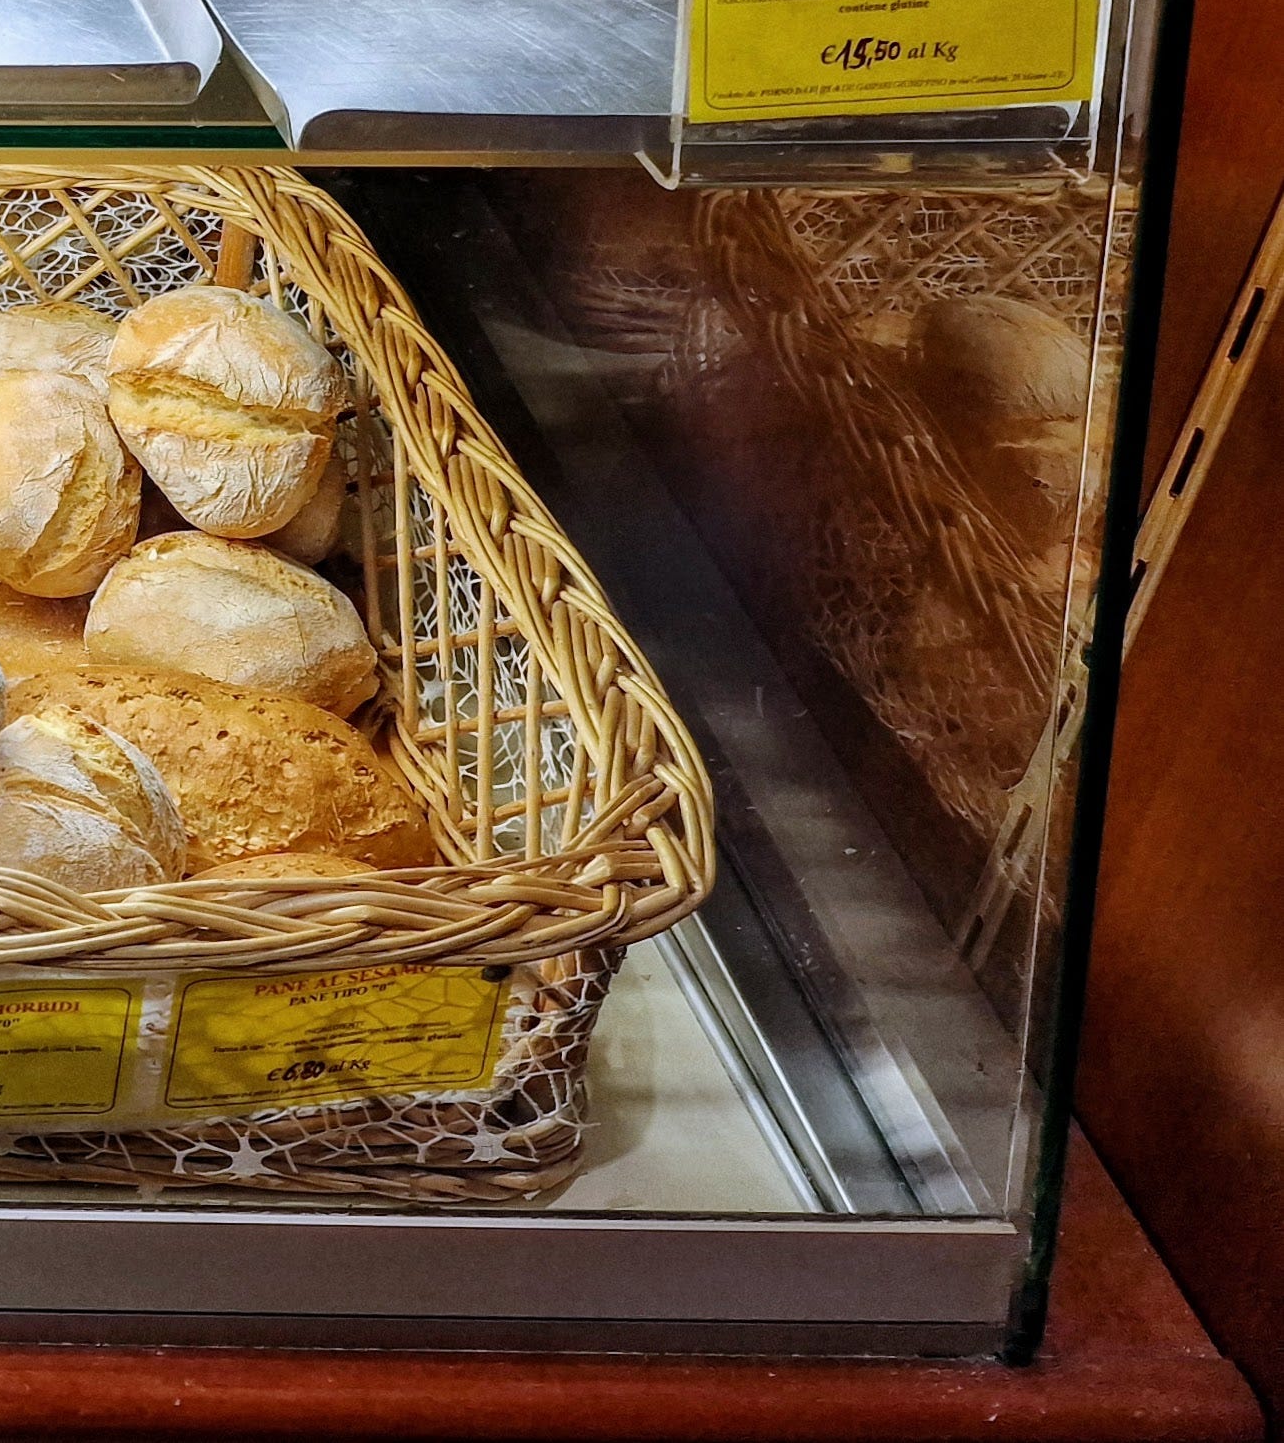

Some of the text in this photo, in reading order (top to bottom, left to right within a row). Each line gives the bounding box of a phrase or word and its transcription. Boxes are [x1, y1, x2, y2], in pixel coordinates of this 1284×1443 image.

[838, 0, 931, 14] contiene glutine
[907, 42, 927, 59] al
[933, 41, 960, 63] Kg
[254, 980, 311, 997] PANE
[315, 975, 344, 989] AL
[289, 992, 328, 1006] PANE
[333, 986, 368, 1000] TIPO
[331, 1061, 345, 1073] al
[351, 1058, 371, 1072] Kg
